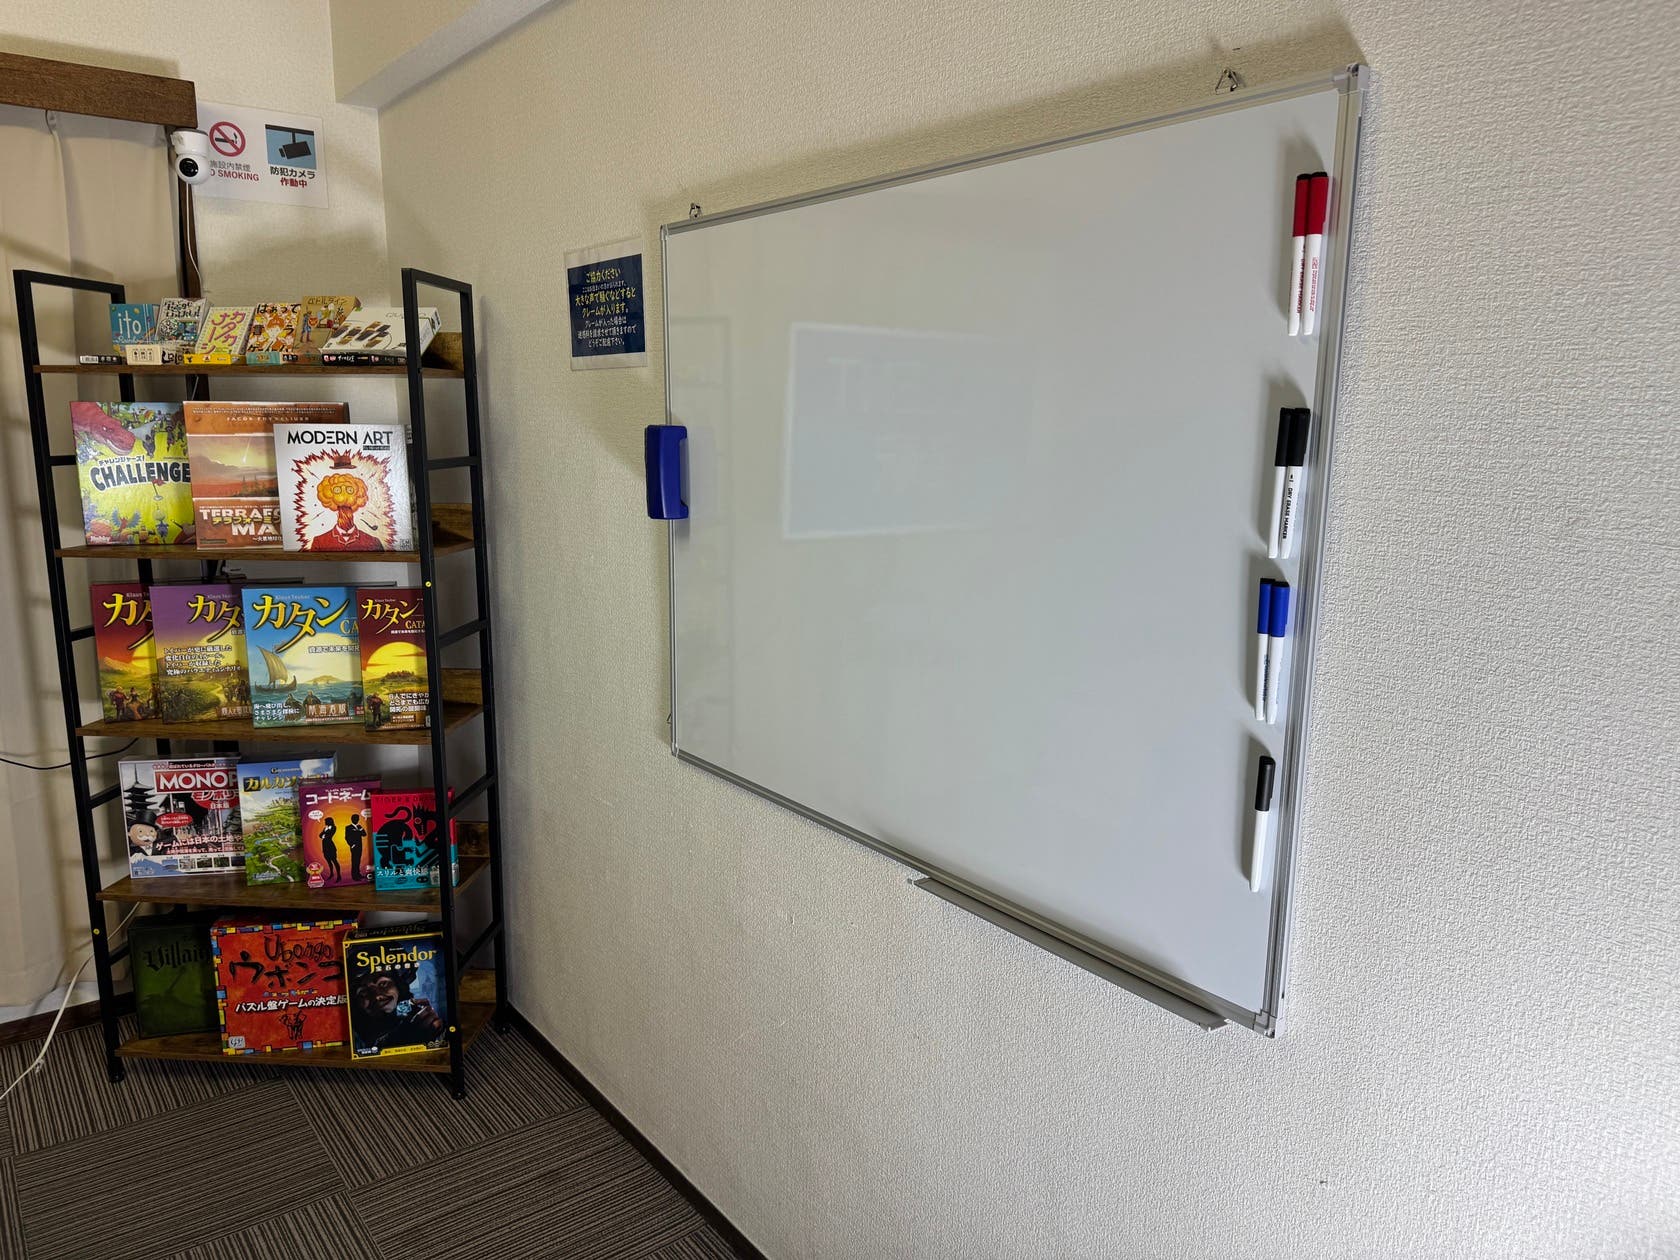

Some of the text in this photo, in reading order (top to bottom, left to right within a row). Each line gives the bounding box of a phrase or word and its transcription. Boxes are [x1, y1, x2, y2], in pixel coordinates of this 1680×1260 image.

[218, 170, 259, 181] SMOKING
[270, 167, 315, 179] 防犯カメラ
[280, 178, 307, 188] 作動中
[117, 310, 142, 338] ito
[287, 430, 393, 445] MODERN ART
[253, 596, 350, 653] カタン
[361, 598, 420, 635] カタン
[305, 790, 371, 805] コードネーム
[264, 935, 333, 962] Ubongo
[357, 945, 437, 973] Splendor
